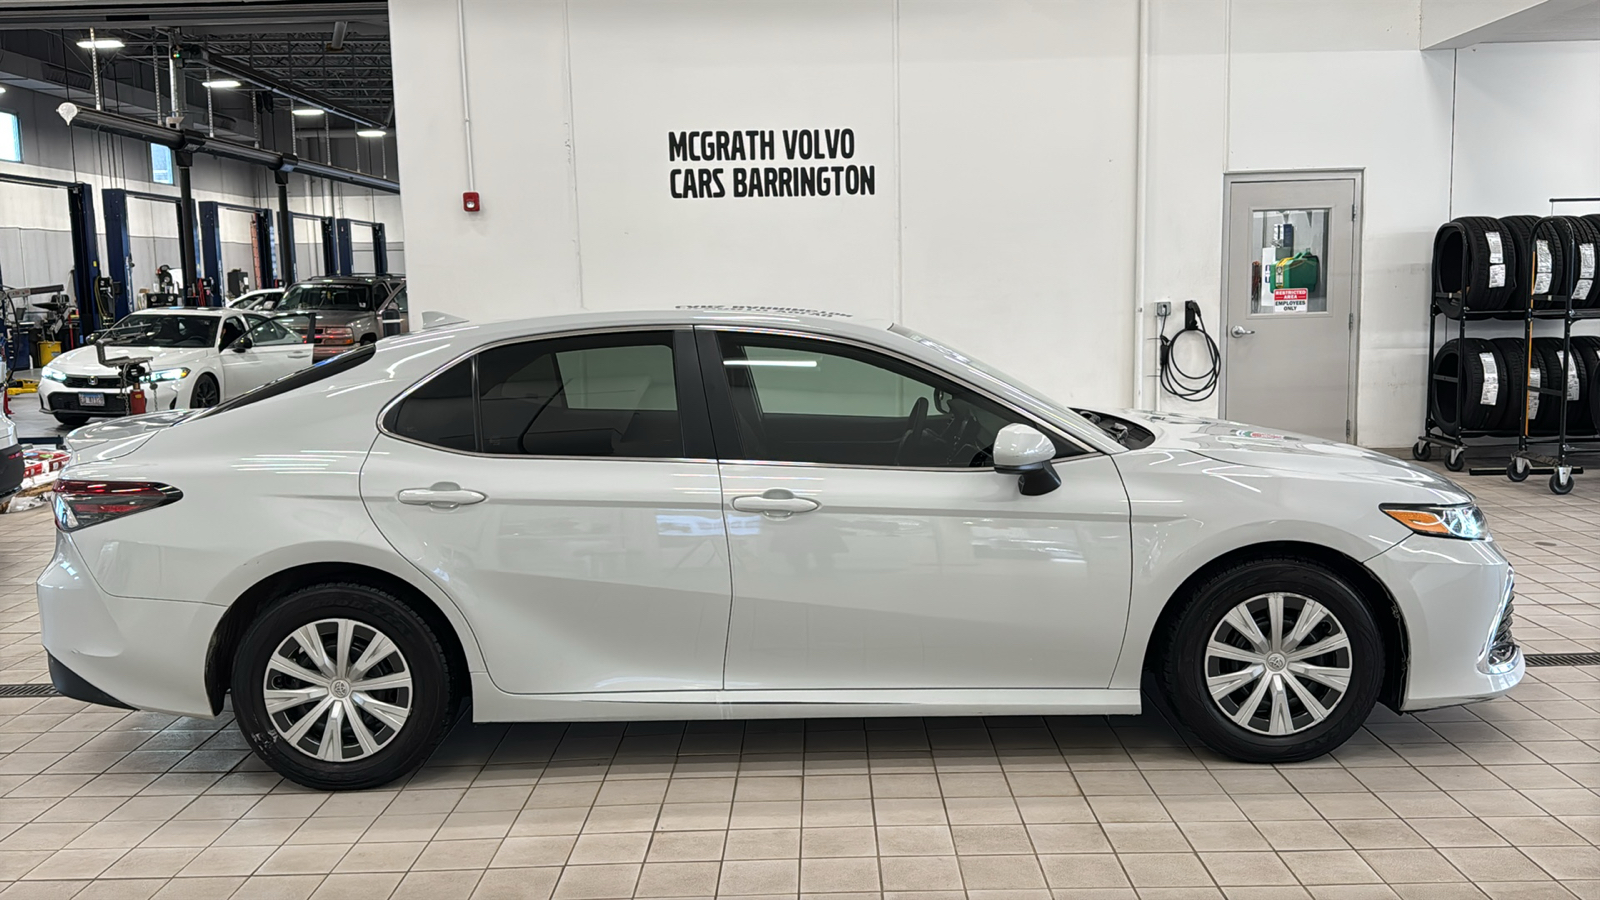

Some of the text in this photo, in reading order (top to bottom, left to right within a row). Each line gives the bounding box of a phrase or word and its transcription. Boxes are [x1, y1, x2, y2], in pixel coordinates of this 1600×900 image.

[668, 128, 855, 161] MCGRATH VOLVO
[670, 165, 876, 199] CARS BARRINGTON
